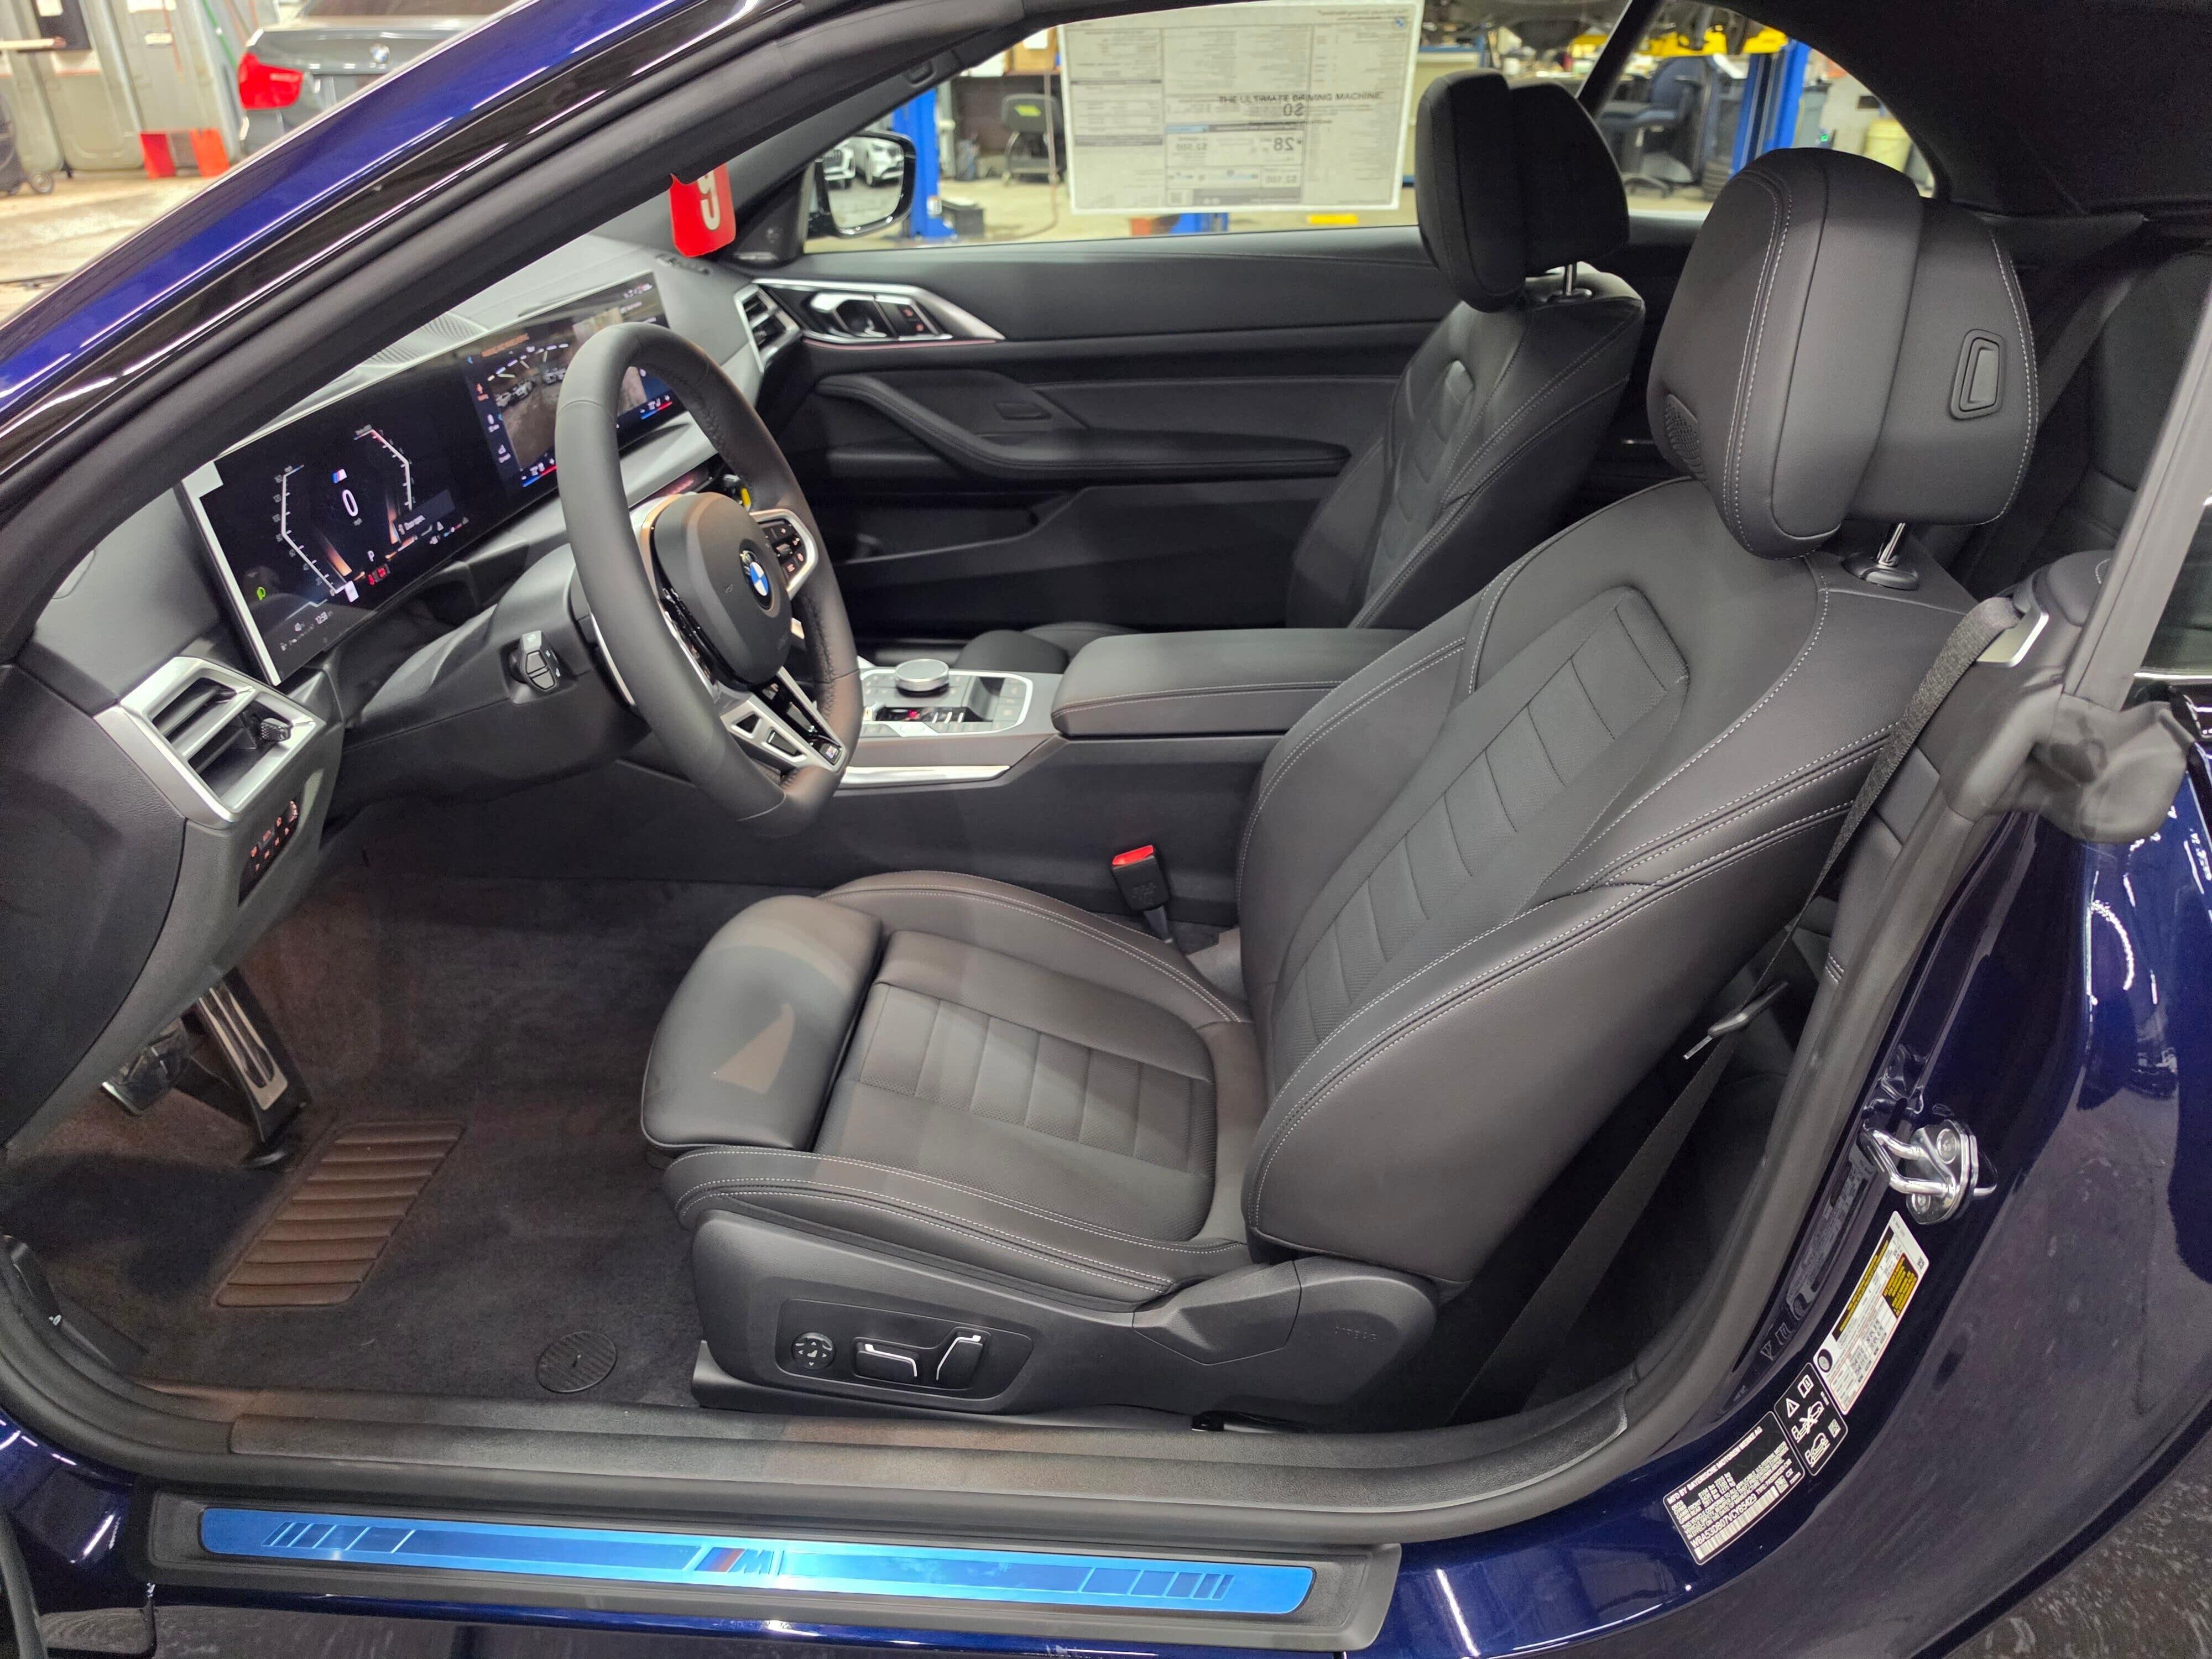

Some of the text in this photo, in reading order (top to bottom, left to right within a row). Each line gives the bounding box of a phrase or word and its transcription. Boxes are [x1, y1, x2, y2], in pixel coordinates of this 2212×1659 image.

[1292, 92, 1332, 102] DRIVING
[1335, 91, 1384, 100] MACHINE
[341, 489, 359, 517] 0
[367, 550, 375, 562] P
